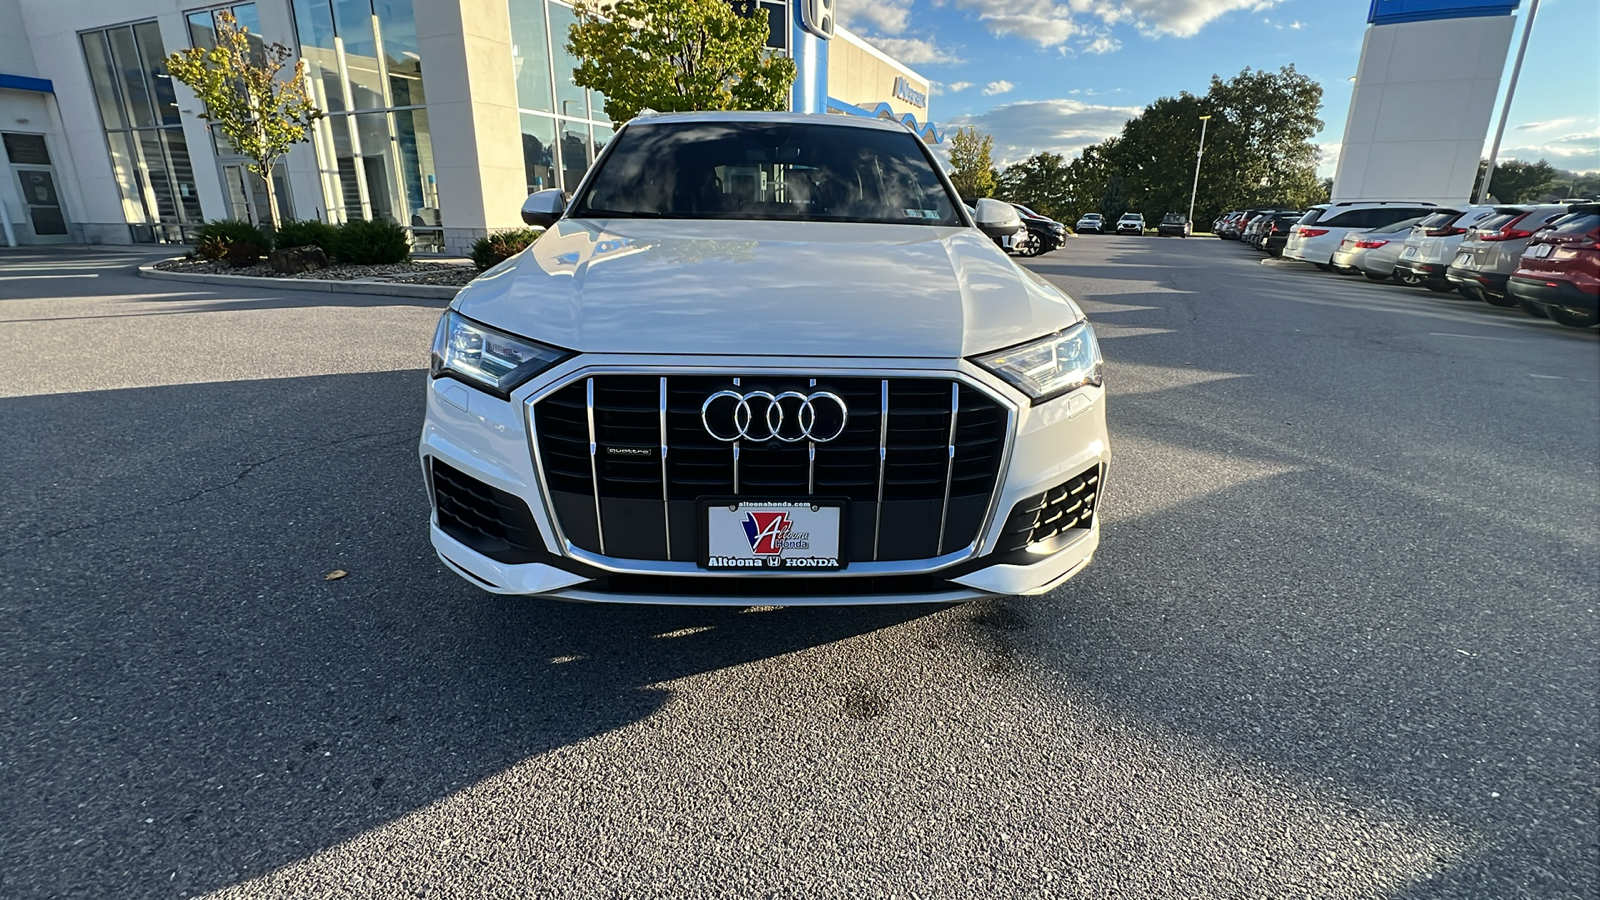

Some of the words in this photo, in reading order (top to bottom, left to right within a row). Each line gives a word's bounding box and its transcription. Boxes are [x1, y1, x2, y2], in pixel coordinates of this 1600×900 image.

[775, 539, 809, 549] Honda
[708, 557, 762, 567] Altoona
[785, 558, 839, 567] HONDA
